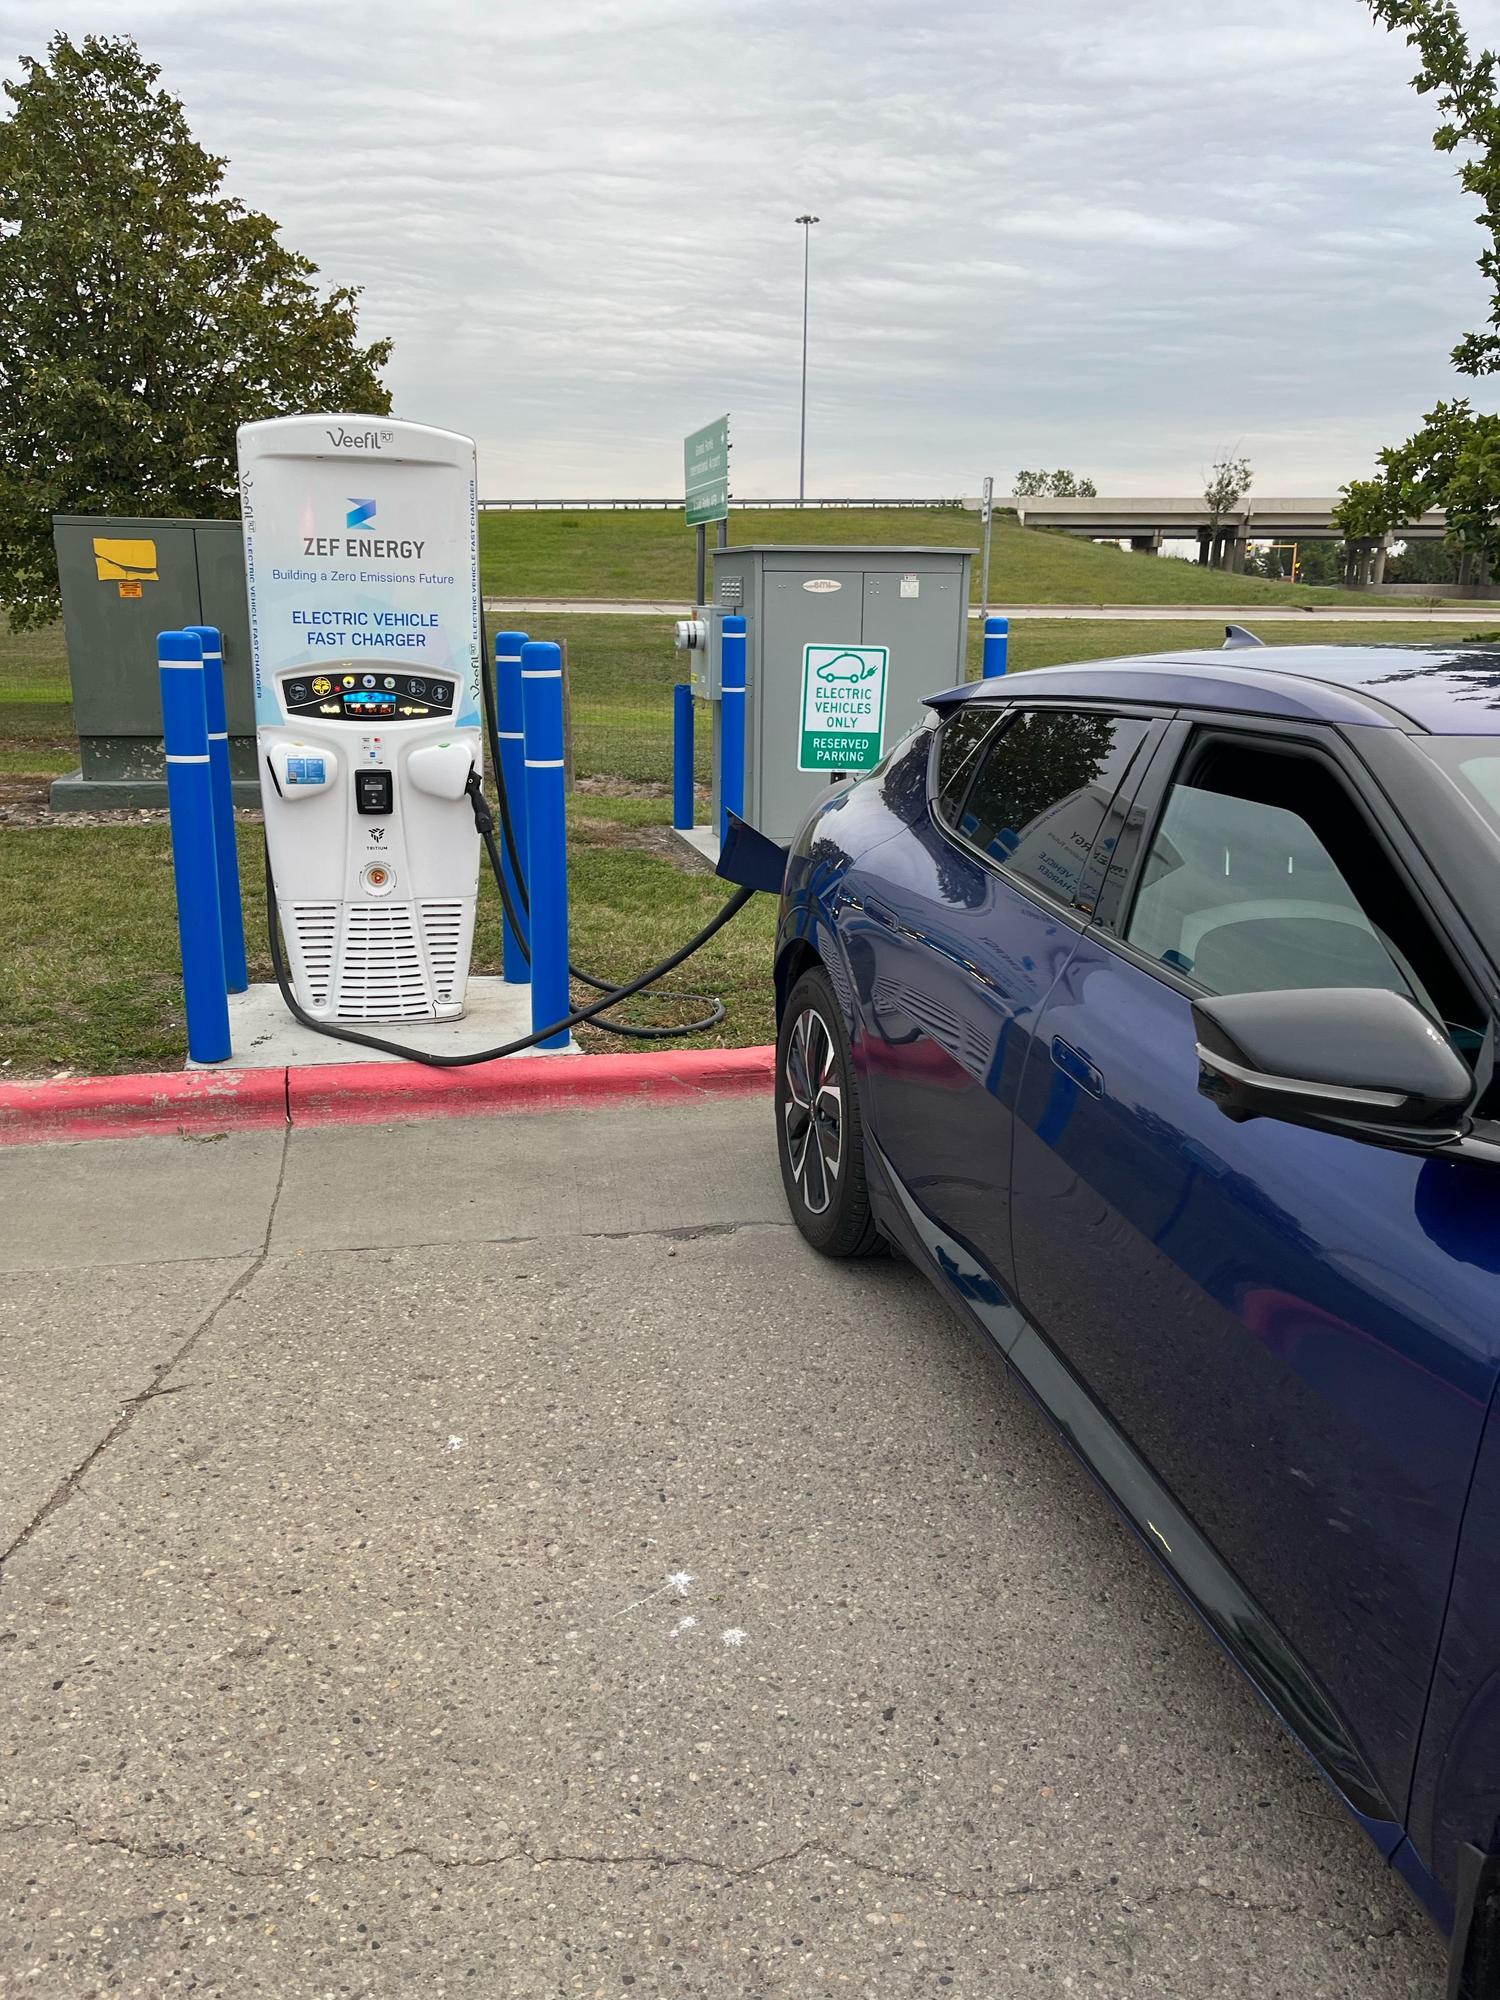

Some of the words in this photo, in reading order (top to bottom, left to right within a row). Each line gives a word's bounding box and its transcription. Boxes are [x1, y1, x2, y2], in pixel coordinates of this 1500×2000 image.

[326, 427, 381, 449] Veefil
[303, 537, 340, 556] ZEF
[346, 538, 425, 559] ENERGY
[272, 569, 317, 583] Building
[320, 572, 328, 581] a
[330, 570, 357, 582] Zero
[360, 571, 416, 584] Emissions
[419, 573, 455, 585] Future
[292, 610, 368, 626] ELECTRIC
[373, 612, 439, 627] VEHICLE
[307, 631, 346, 646] FAST
[351, 632, 426, 647] CHARGER
[816, 687, 872, 699] ELECTRIC
[815, 702, 871, 714] VEHICLES
[826, 716, 858, 728] ONLY
[813, 738, 869, 749] RESERVED
[816, 751, 864, 762] PARKING
